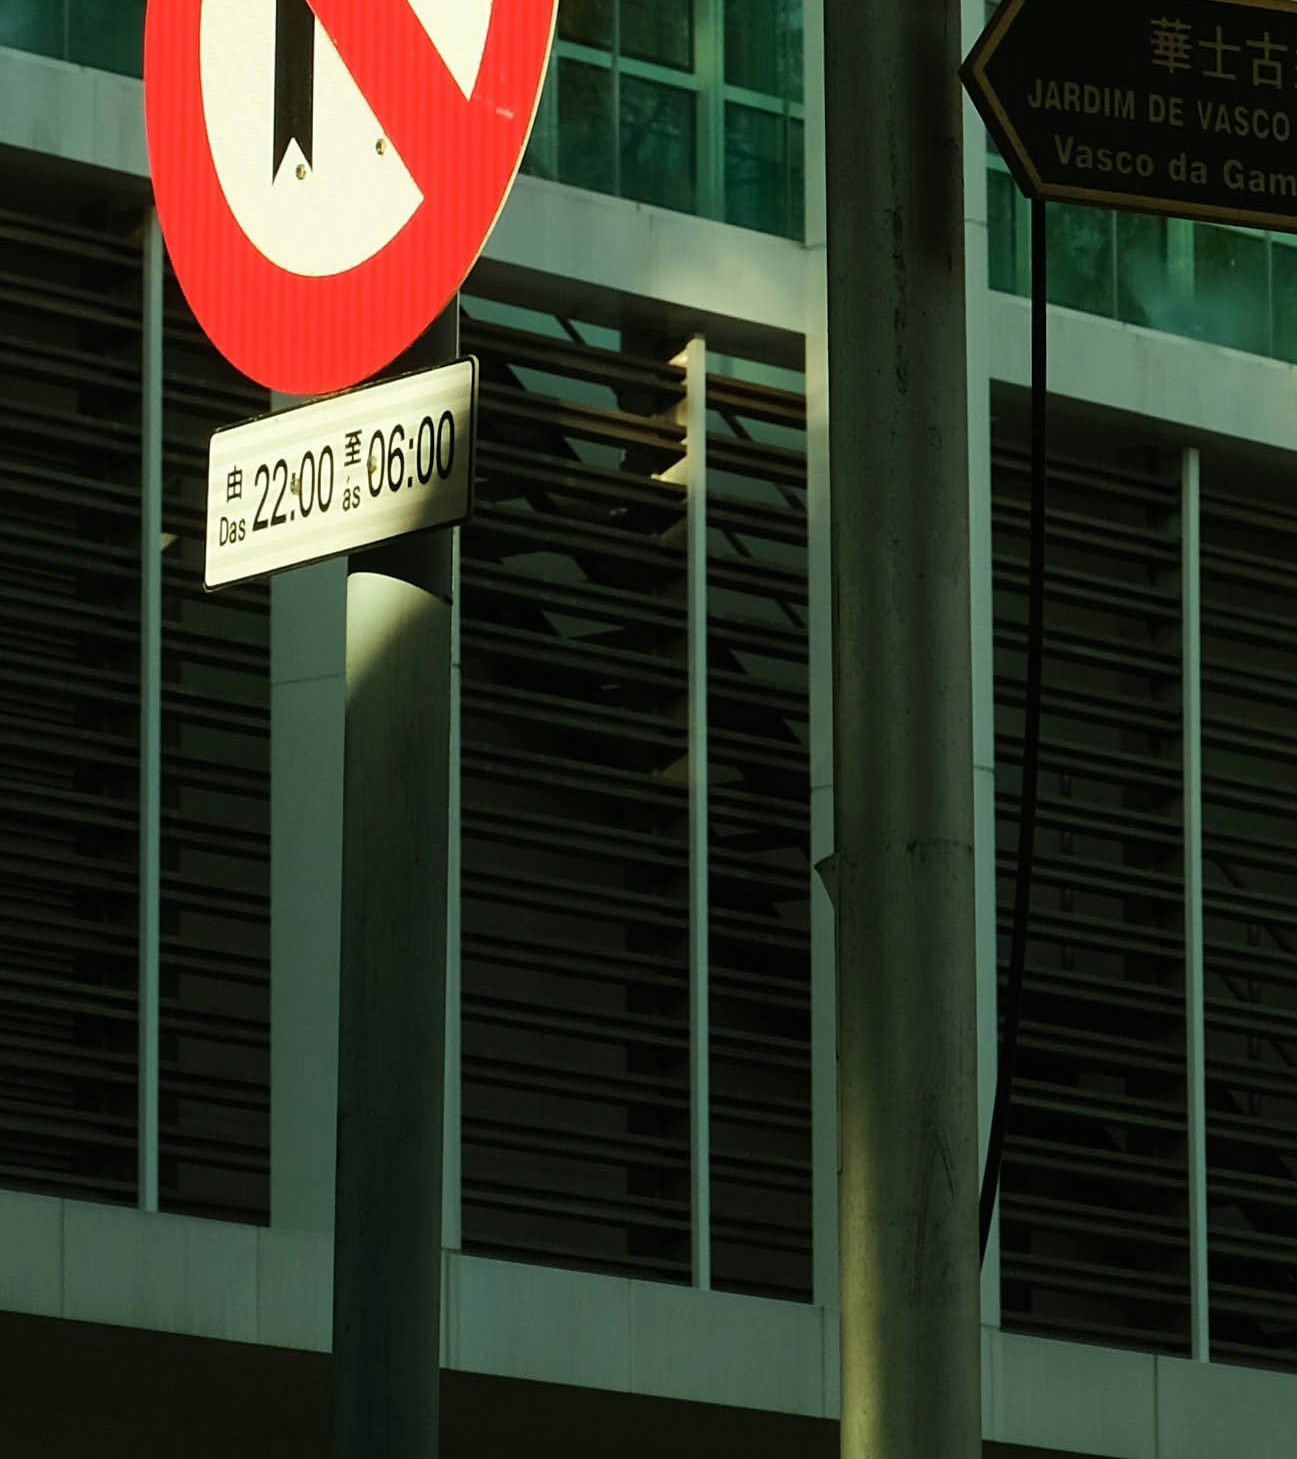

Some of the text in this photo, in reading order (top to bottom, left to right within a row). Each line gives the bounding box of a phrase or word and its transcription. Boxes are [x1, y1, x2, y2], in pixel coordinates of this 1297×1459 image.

[1027, 78, 1136, 122] JARDIM
[1148, 93, 1185, 127] DE
[1197, 100, 1291, 141] VASCO
[1054, 134, 1155, 178] Vasco
[1168, 153, 1208, 185] da
[226, 410, 455, 532] 由 22:00 至 06:00
[219, 515, 247, 547] Das
